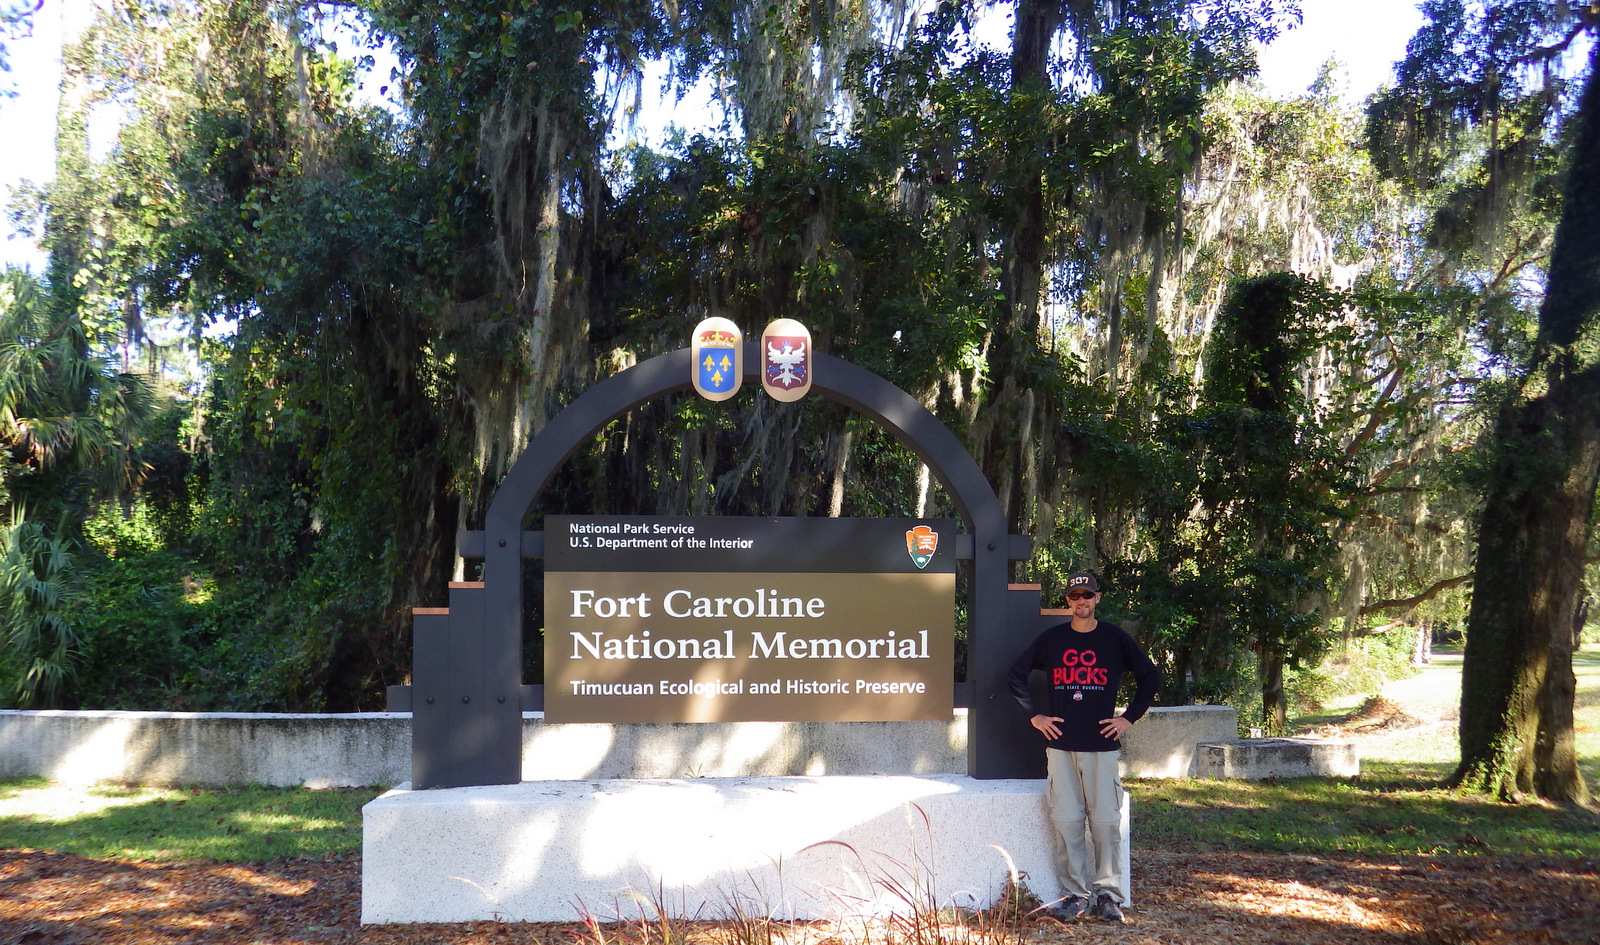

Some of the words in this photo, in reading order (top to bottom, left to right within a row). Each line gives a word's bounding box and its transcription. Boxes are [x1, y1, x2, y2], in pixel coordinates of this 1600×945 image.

[569, 523, 620, 534] National
[624, 523, 650, 534] Park
[652, 523, 695, 534] Service
[569, 536, 593, 548] U.S.
[596, 536, 668, 551] Department
[671, 536, 684, 548] of
[686, 536, 707, 549] the
[709, 537, 754, 549] Interior
[569, 589, 652, 618] Fort
[663, 588, 825, 618] Caroline
[569, 629, 736, 660] National
[748, 629, 931, 660] Memorial
[1062, 648, 1097, 667] GO
[1052, 666, 1108, 686] BUCKS
[570, 679, 654, 696] Timucuan
[660, 679, 743, 700] Ecological
[748, 679, 781, 696] and
[786, 678, 850, 696] Historic
[855, 679, 926, 696] Preserve
